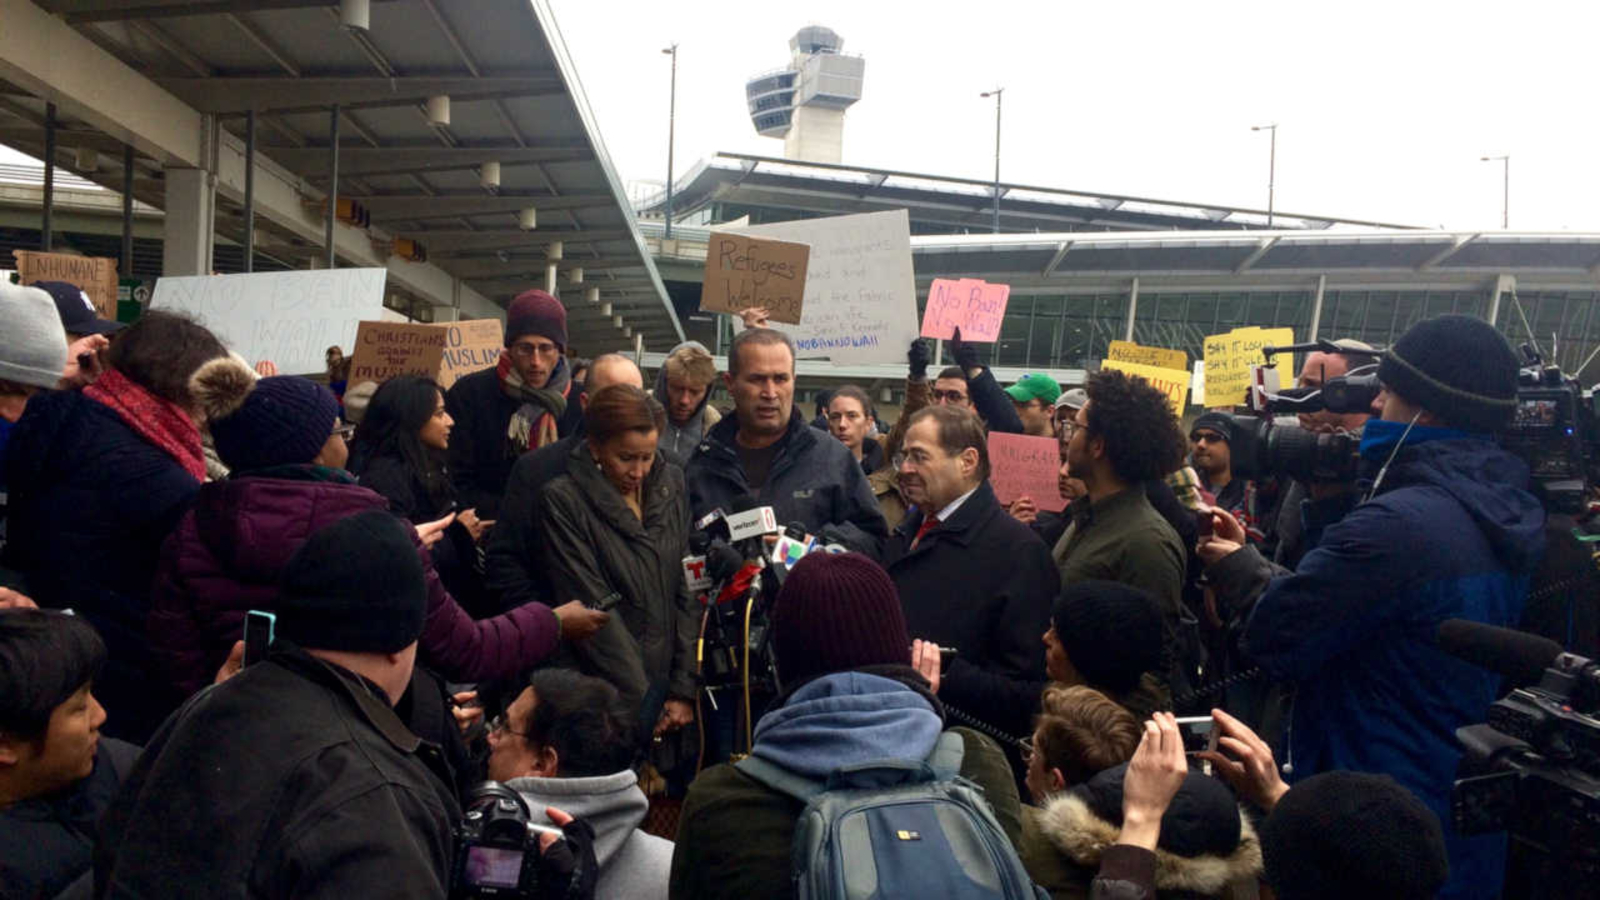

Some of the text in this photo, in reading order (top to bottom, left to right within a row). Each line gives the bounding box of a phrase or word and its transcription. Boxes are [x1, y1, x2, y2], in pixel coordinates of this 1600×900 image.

[26, 257, 103, 282] INHUMANE
[719, 239, 795, 285] Refugees
[160, 277, 246, 313] NO
[271, 270, 380, 311] BAN
[726, 278, 801, 319] Welcome
[935, 285, 961, 309] No
[928, 306, 955, 330] No
[448, 326, 462, 348] O
[1207, 340, 1226, 355] SAY
[1207, 359, 1227, 371] SAY
[1244, 354, 1278, 366] CLER
[733, 518, 761, 531] verizon
[686, 560, 705, 581] T
